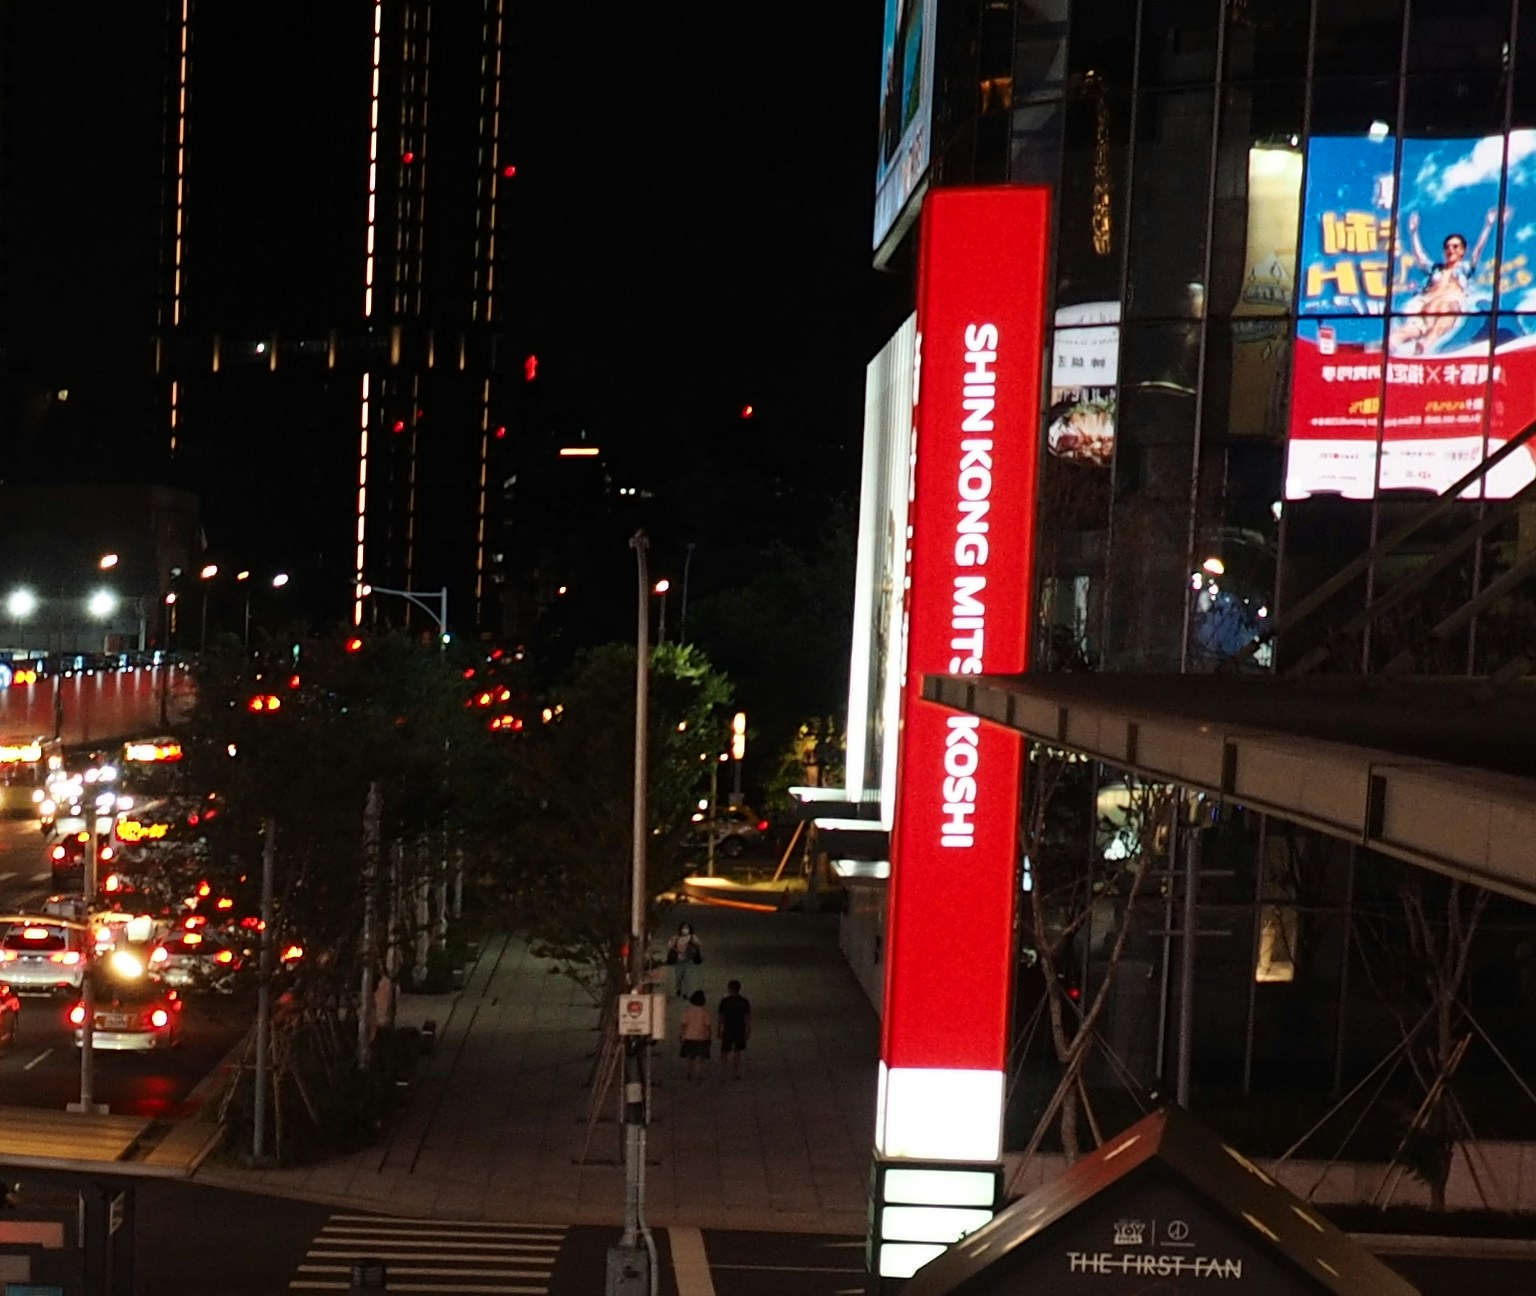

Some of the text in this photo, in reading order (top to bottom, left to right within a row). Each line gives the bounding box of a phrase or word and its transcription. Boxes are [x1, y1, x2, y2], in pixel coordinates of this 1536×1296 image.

[940, 323, 999, 848] SHIN KONG MITSKOSHI
[1066, 1252, 1243, 1280] THE FIRST FAN
